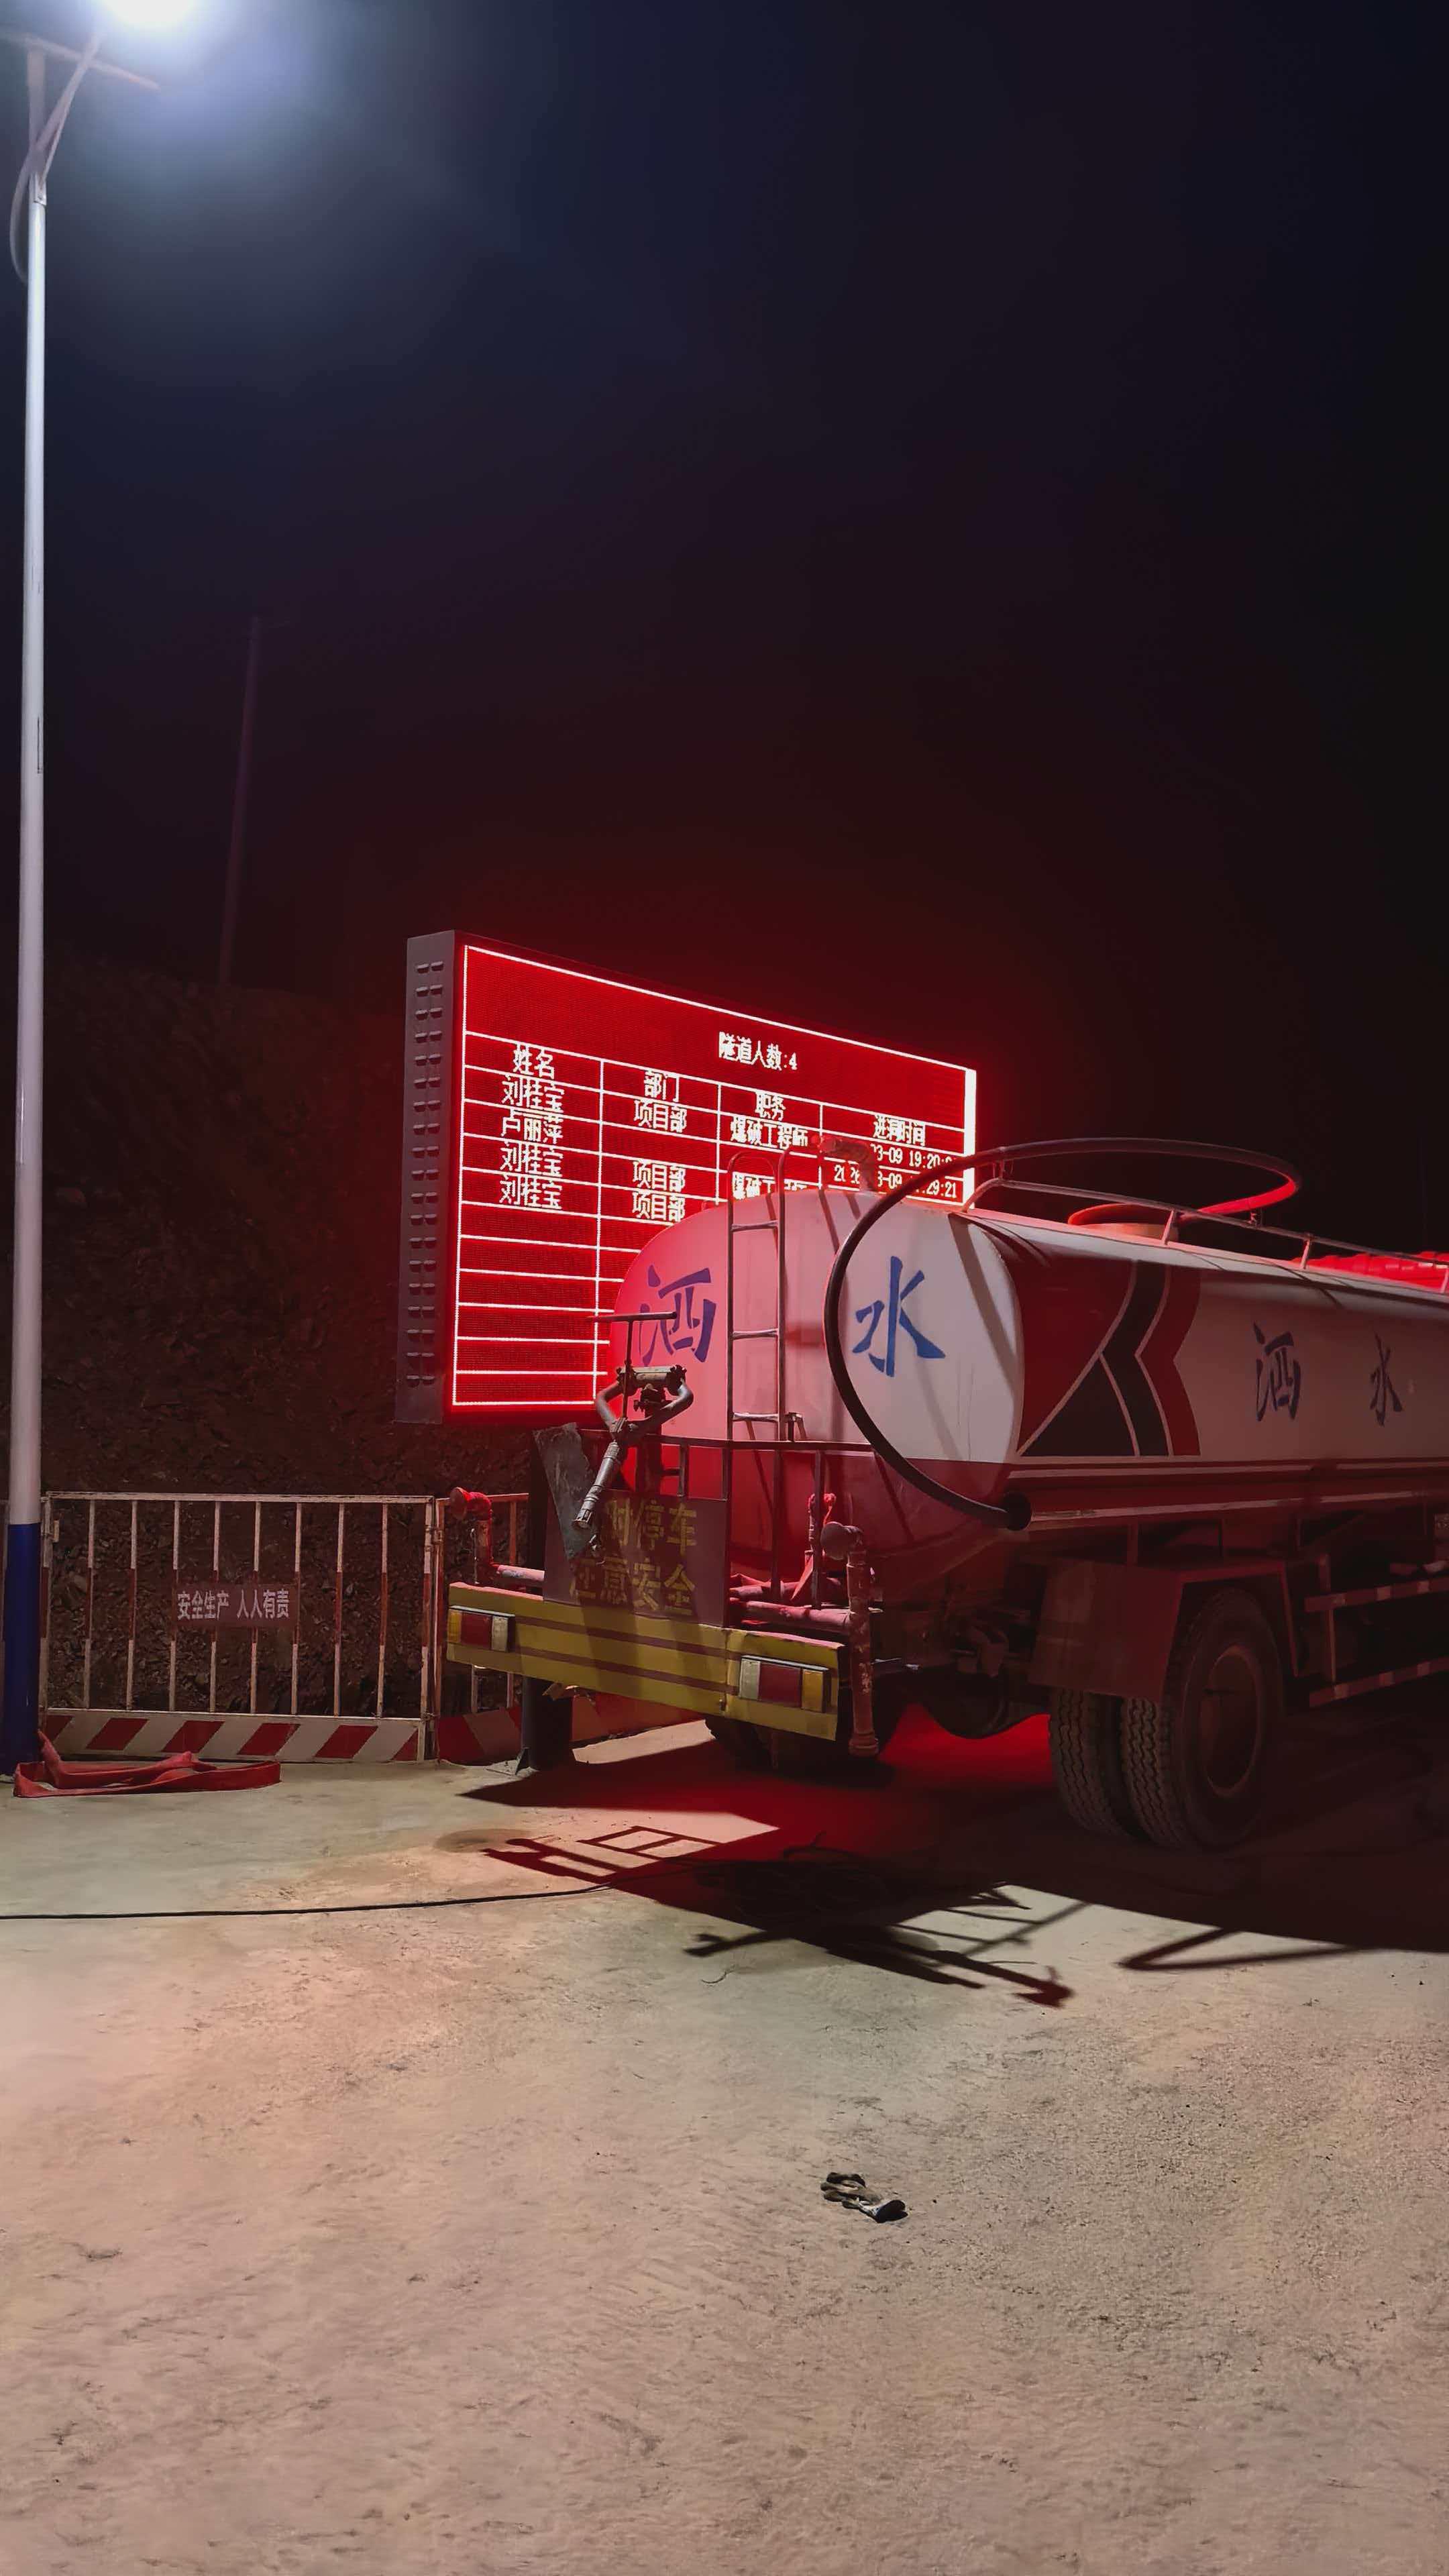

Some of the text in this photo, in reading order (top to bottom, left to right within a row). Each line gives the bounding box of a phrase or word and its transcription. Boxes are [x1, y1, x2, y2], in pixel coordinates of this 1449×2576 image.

[513, 1042, 555, 1079] 姓名
[501, 1074, 565, 1113] 刘桂宝
[643, 1069, 680, 1103] 部门
[633, 1099, 688, 1133] 项目部
[755, 1091, 786, 1121] 职务
[499, 1140, 564, 1177] 刘桂宝
[498, 1174, 563, 1210] 刘桂宝
[632, 1159, 686, 1193] 项目部
[631, 1191, 686, 1223] 项目部
[177, 1588, 290, 1621] 安全生产 人人有责
